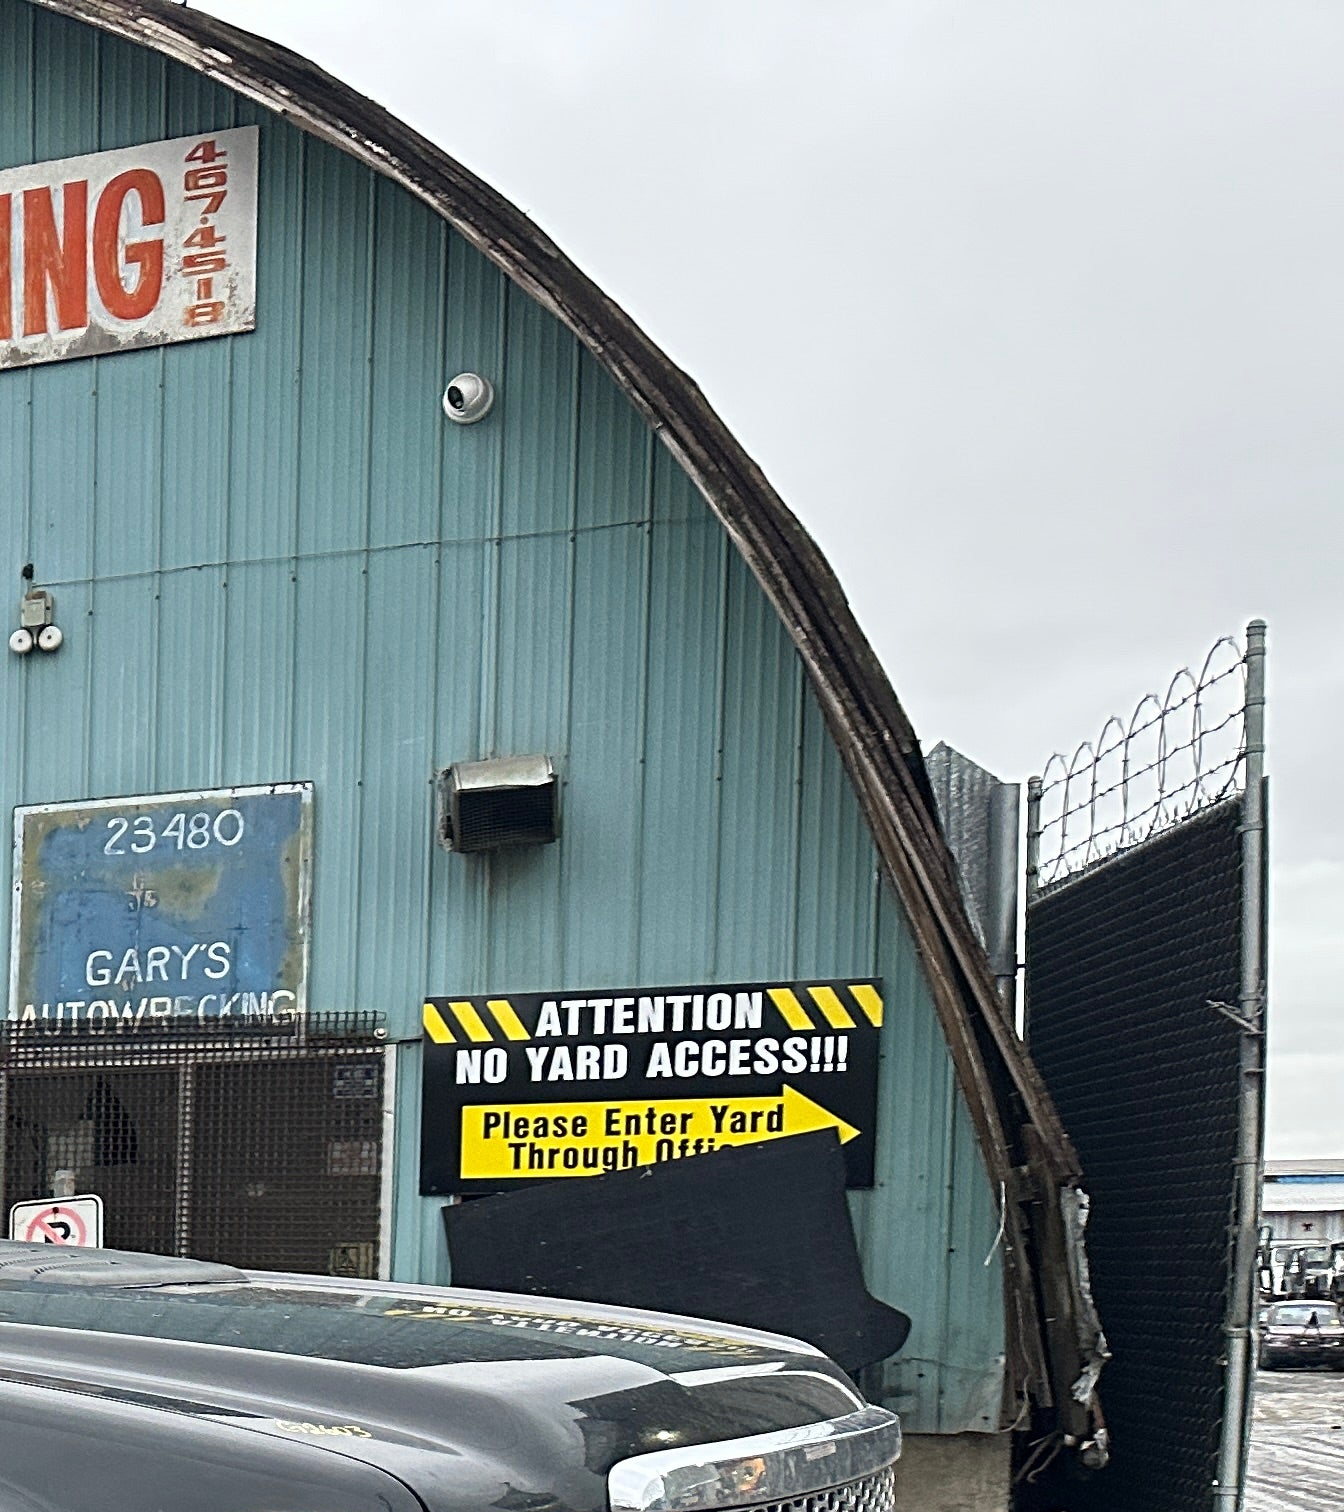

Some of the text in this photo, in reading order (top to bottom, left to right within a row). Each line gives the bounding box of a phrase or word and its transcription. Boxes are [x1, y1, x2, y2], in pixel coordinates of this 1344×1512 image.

[104, 809, 245, 856] 23480
[85, 941, 231, 989] GARY'S
[535, 991, 764, 1038] ATTENTION
[455, 1035, 849, 1085] NO YARD ACCESS!!!
[483, 1102, 785, 1140] Please Enter Yard
[507, 1137, 734, 1173] Through Offi
